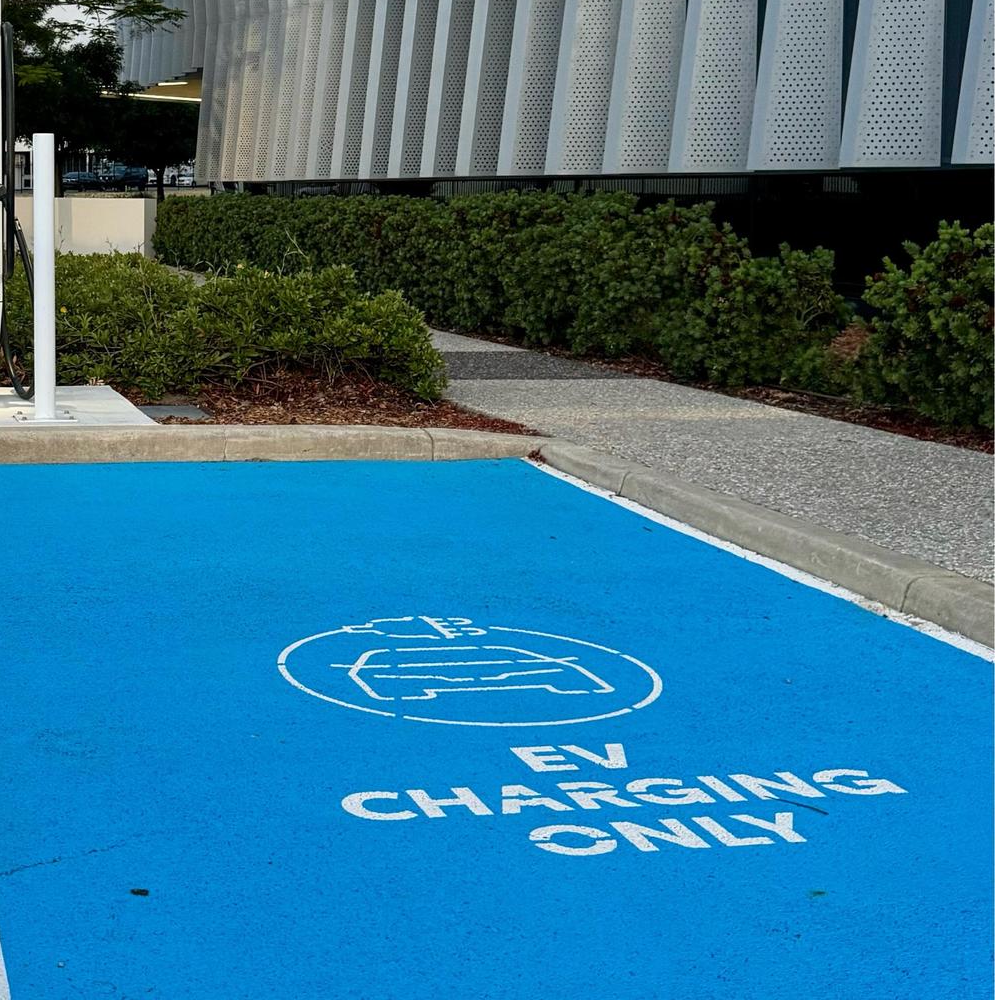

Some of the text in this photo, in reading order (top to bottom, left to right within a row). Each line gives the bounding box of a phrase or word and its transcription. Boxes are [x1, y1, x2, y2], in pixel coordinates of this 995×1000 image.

[509, 742, 628, 772] EV
[341, 767, 908, 821] CHARGING
[528, 812, 808, 857] ONLY
